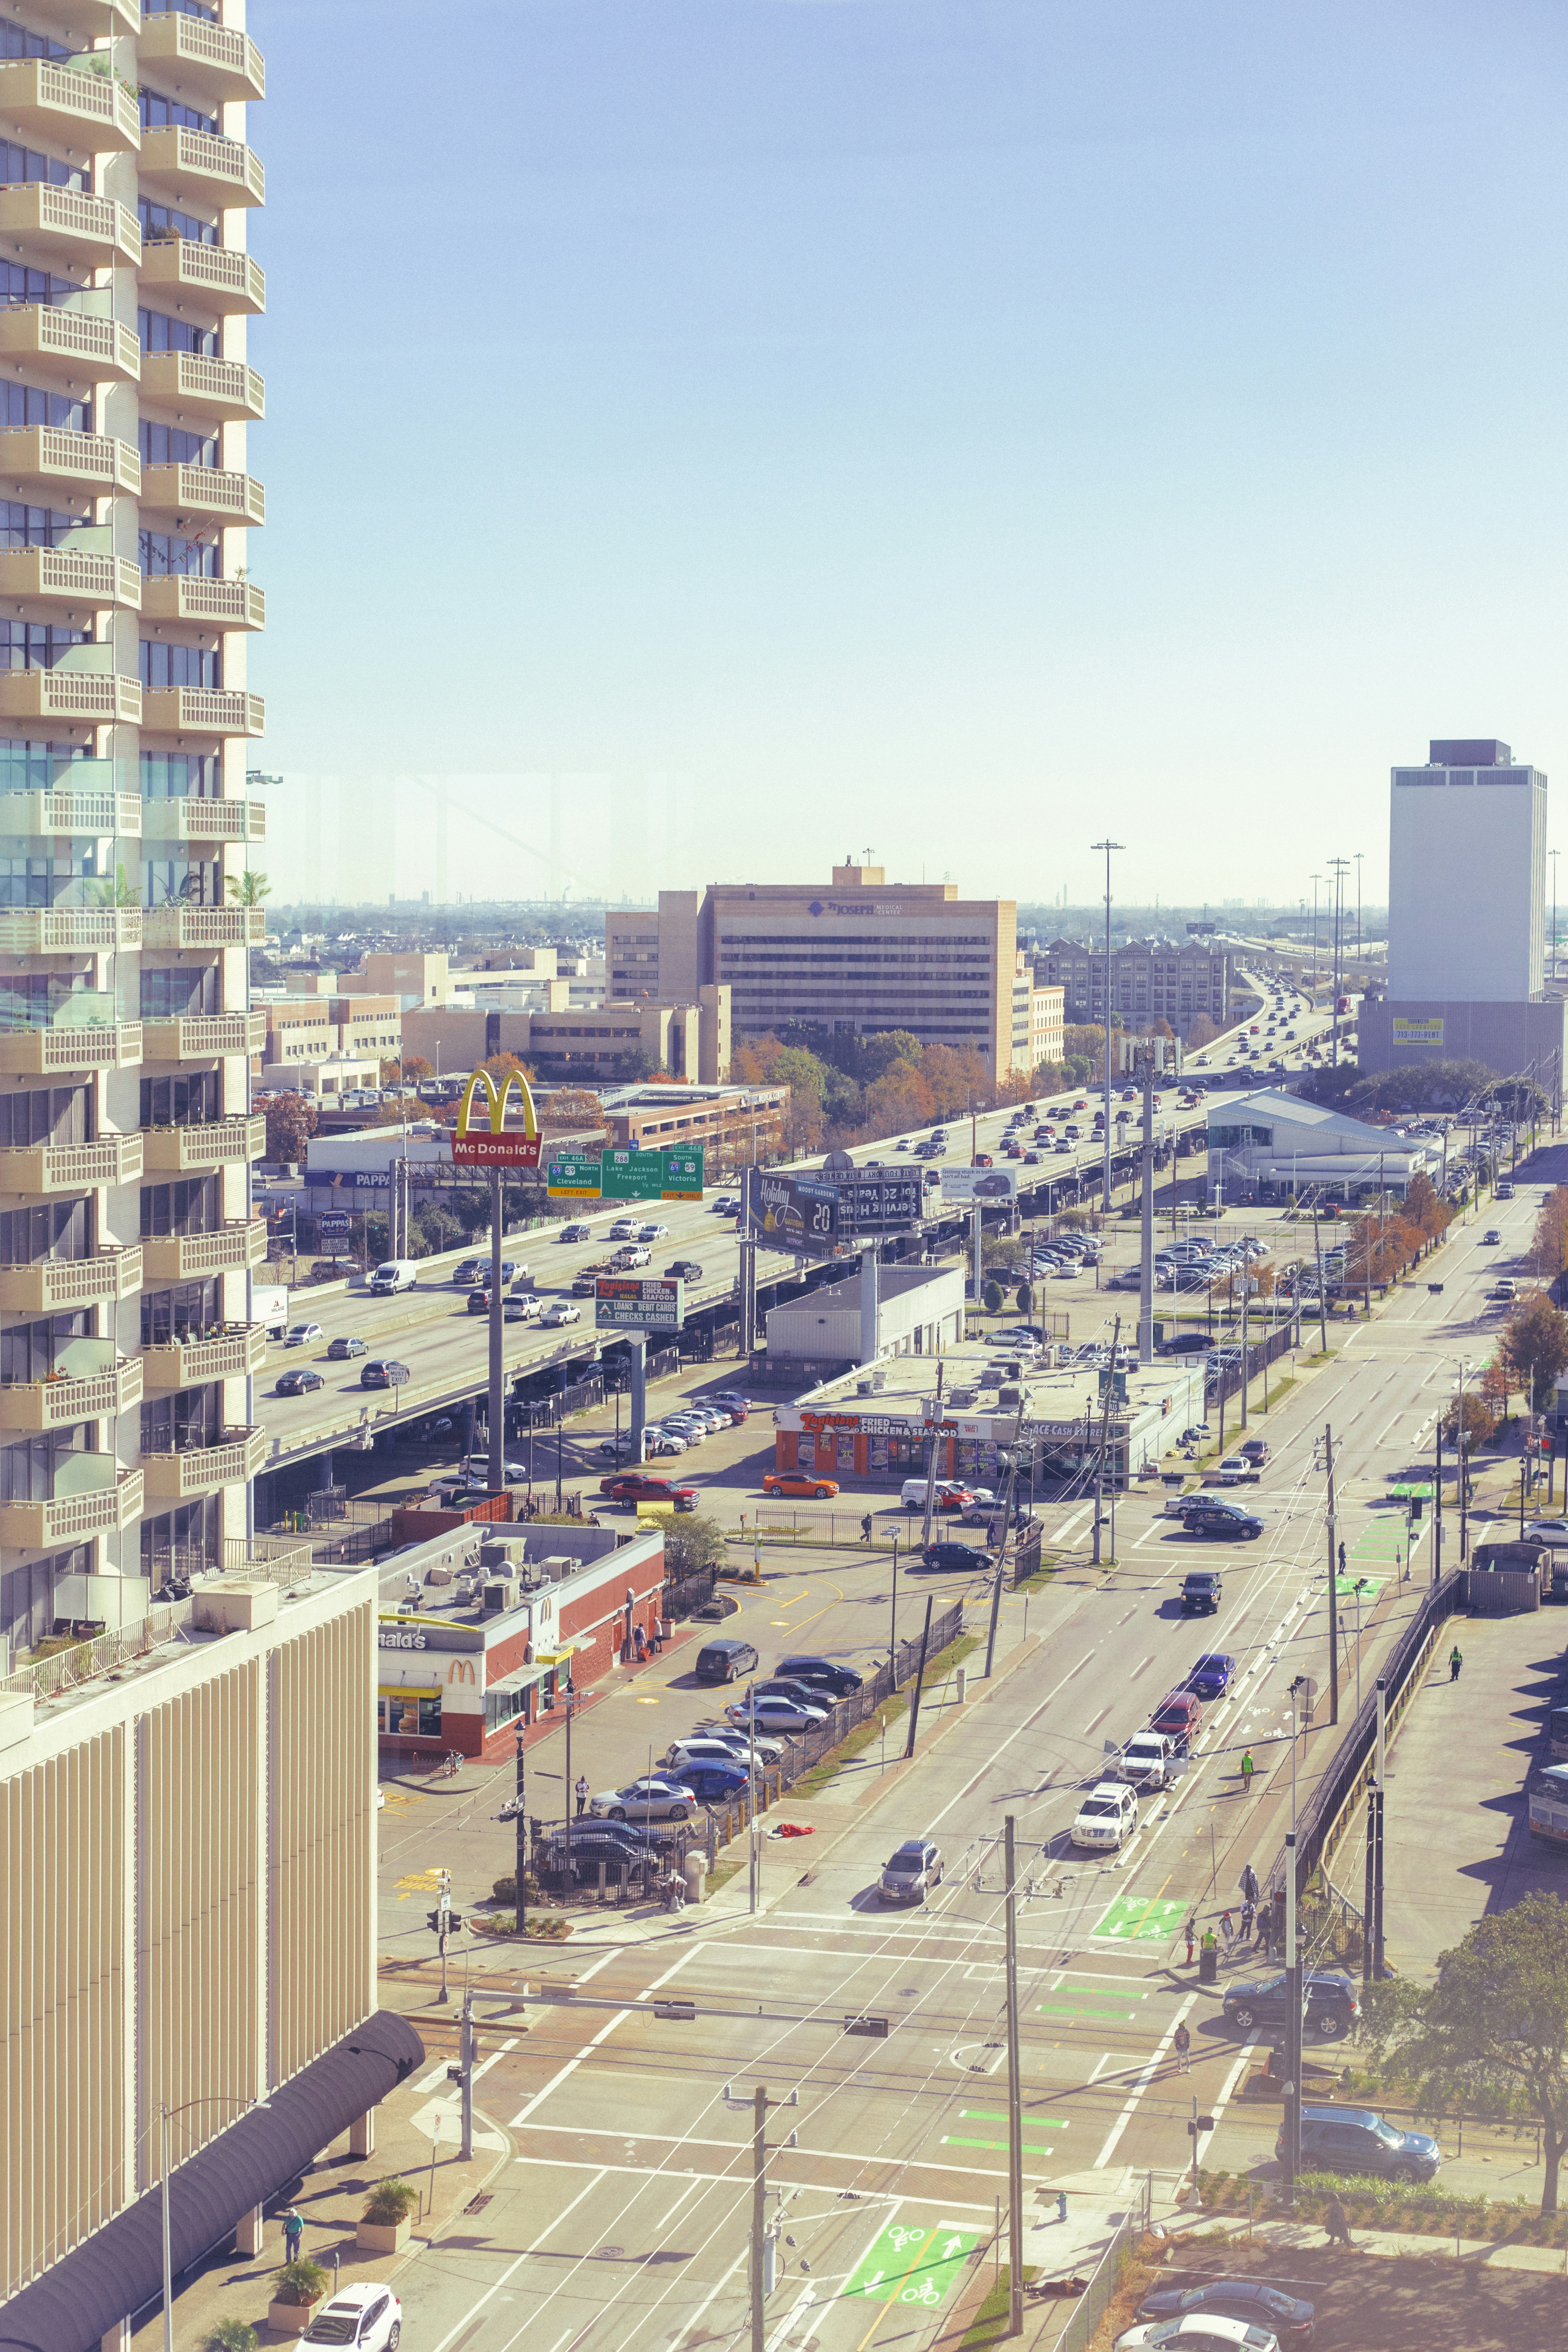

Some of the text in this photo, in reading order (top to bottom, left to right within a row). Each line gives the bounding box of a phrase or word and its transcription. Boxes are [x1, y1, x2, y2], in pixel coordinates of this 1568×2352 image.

[836, 905, 874, 915] JOSEPH
[455, 1143, 537, 1155] McDonald's
[798, 1186, 834, 1198] MOODY GARDENS
[813, 1203, 830, 1231] 20
[322, 1219, 349, 1228] PAPPAS
[785, 1218, 804, 1228] GARDENS
[597, 1280, 639, 1297] Louisiana
[614, 1302, 675, 1312] LOANS DEBIT CARDS
[615, 1312, 643, 1321] CHECKS
[645, 1313, 674, 1322] CASHED
[800, 1413, 859, 1432] Louisiana
[861, 1418, 890, 1427] FRIED
[861, 1426, 911, 1436] CHICKEN &
[1033, 1424, 1050, 1435] ACE
[1051, 1425, 1073, 1436] CASH
